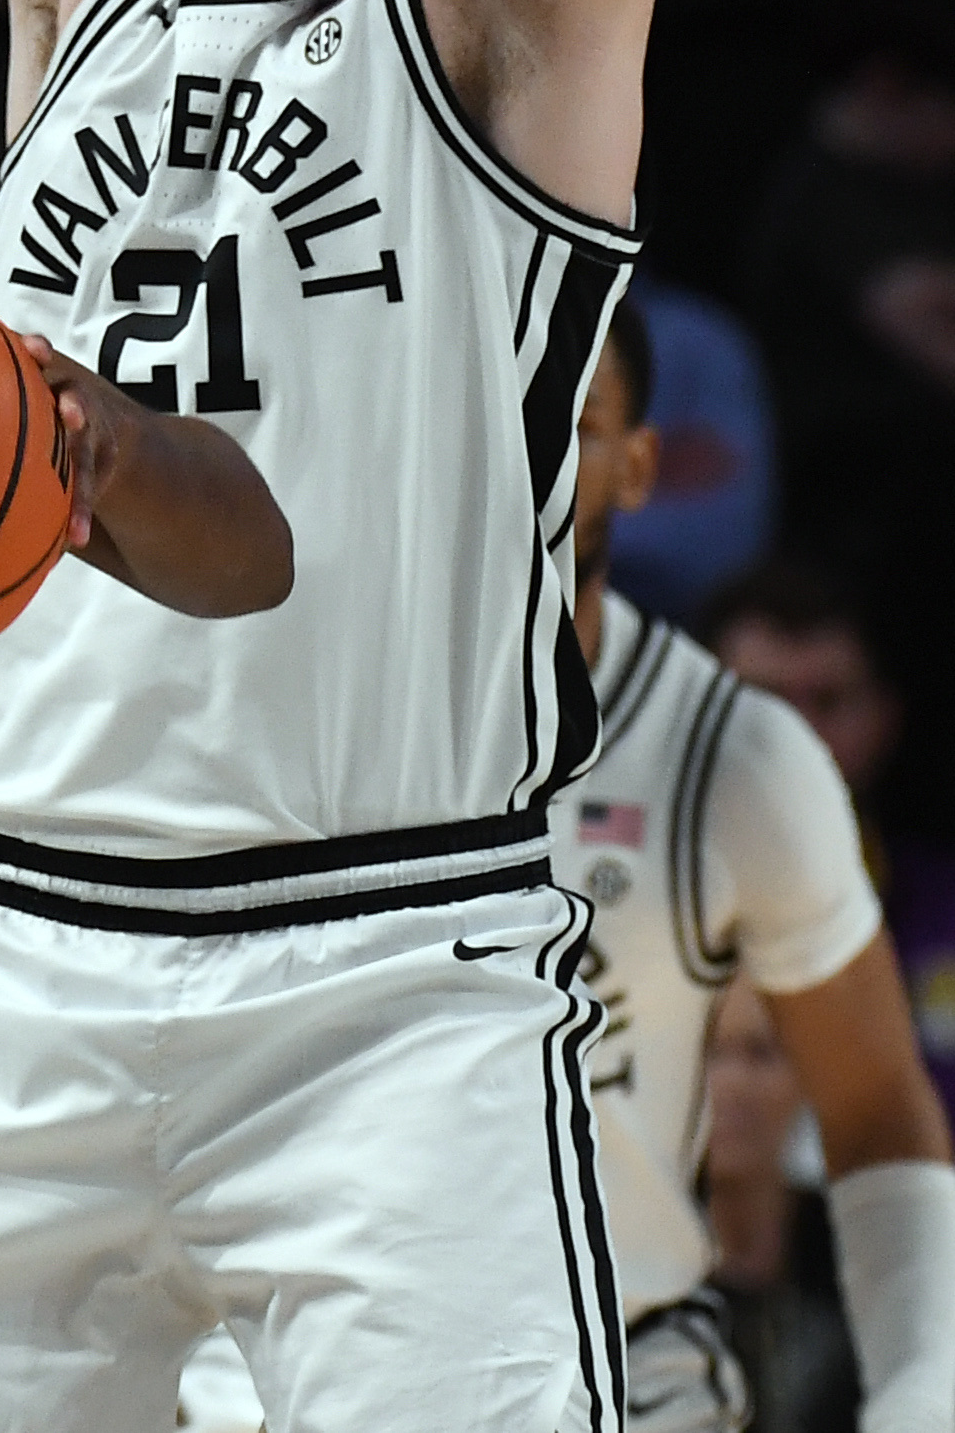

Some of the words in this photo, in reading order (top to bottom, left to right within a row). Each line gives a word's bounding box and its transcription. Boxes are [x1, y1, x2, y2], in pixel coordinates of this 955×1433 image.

[305, 17, 342, 64] SEC
[8, 73, 403, 303] VANERBILT
[97, 234, 261, 413] 21
